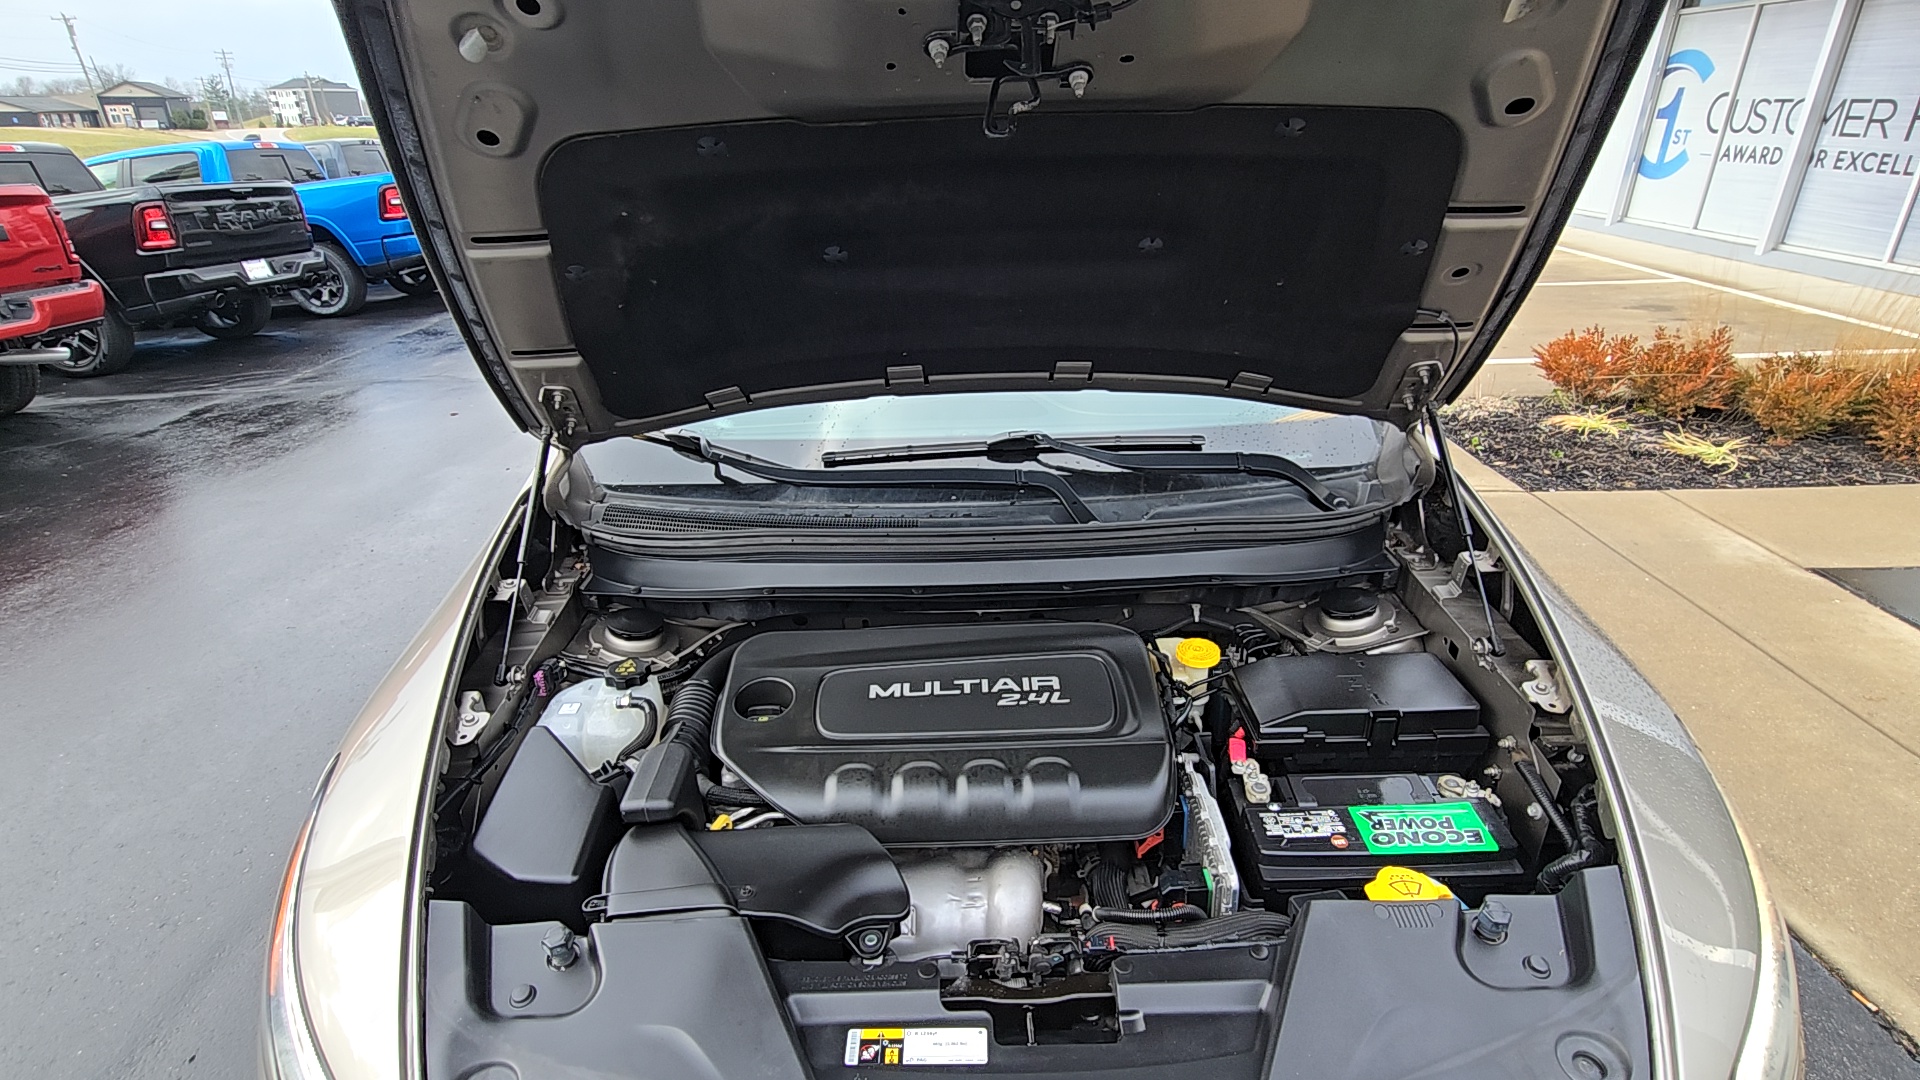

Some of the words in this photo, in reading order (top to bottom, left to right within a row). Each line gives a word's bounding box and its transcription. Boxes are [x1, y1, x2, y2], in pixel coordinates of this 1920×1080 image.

[1719, 144, 1783, 165] AWARD
[216, 208, 282, 225] RAM
[868, 675, 1061, 699] MULTIAIR
[996, 691, 1071, 707] 2.4L
[1371, 816, 1454, 831] POWER
[1371, 829, 1485, 846] ECONO
